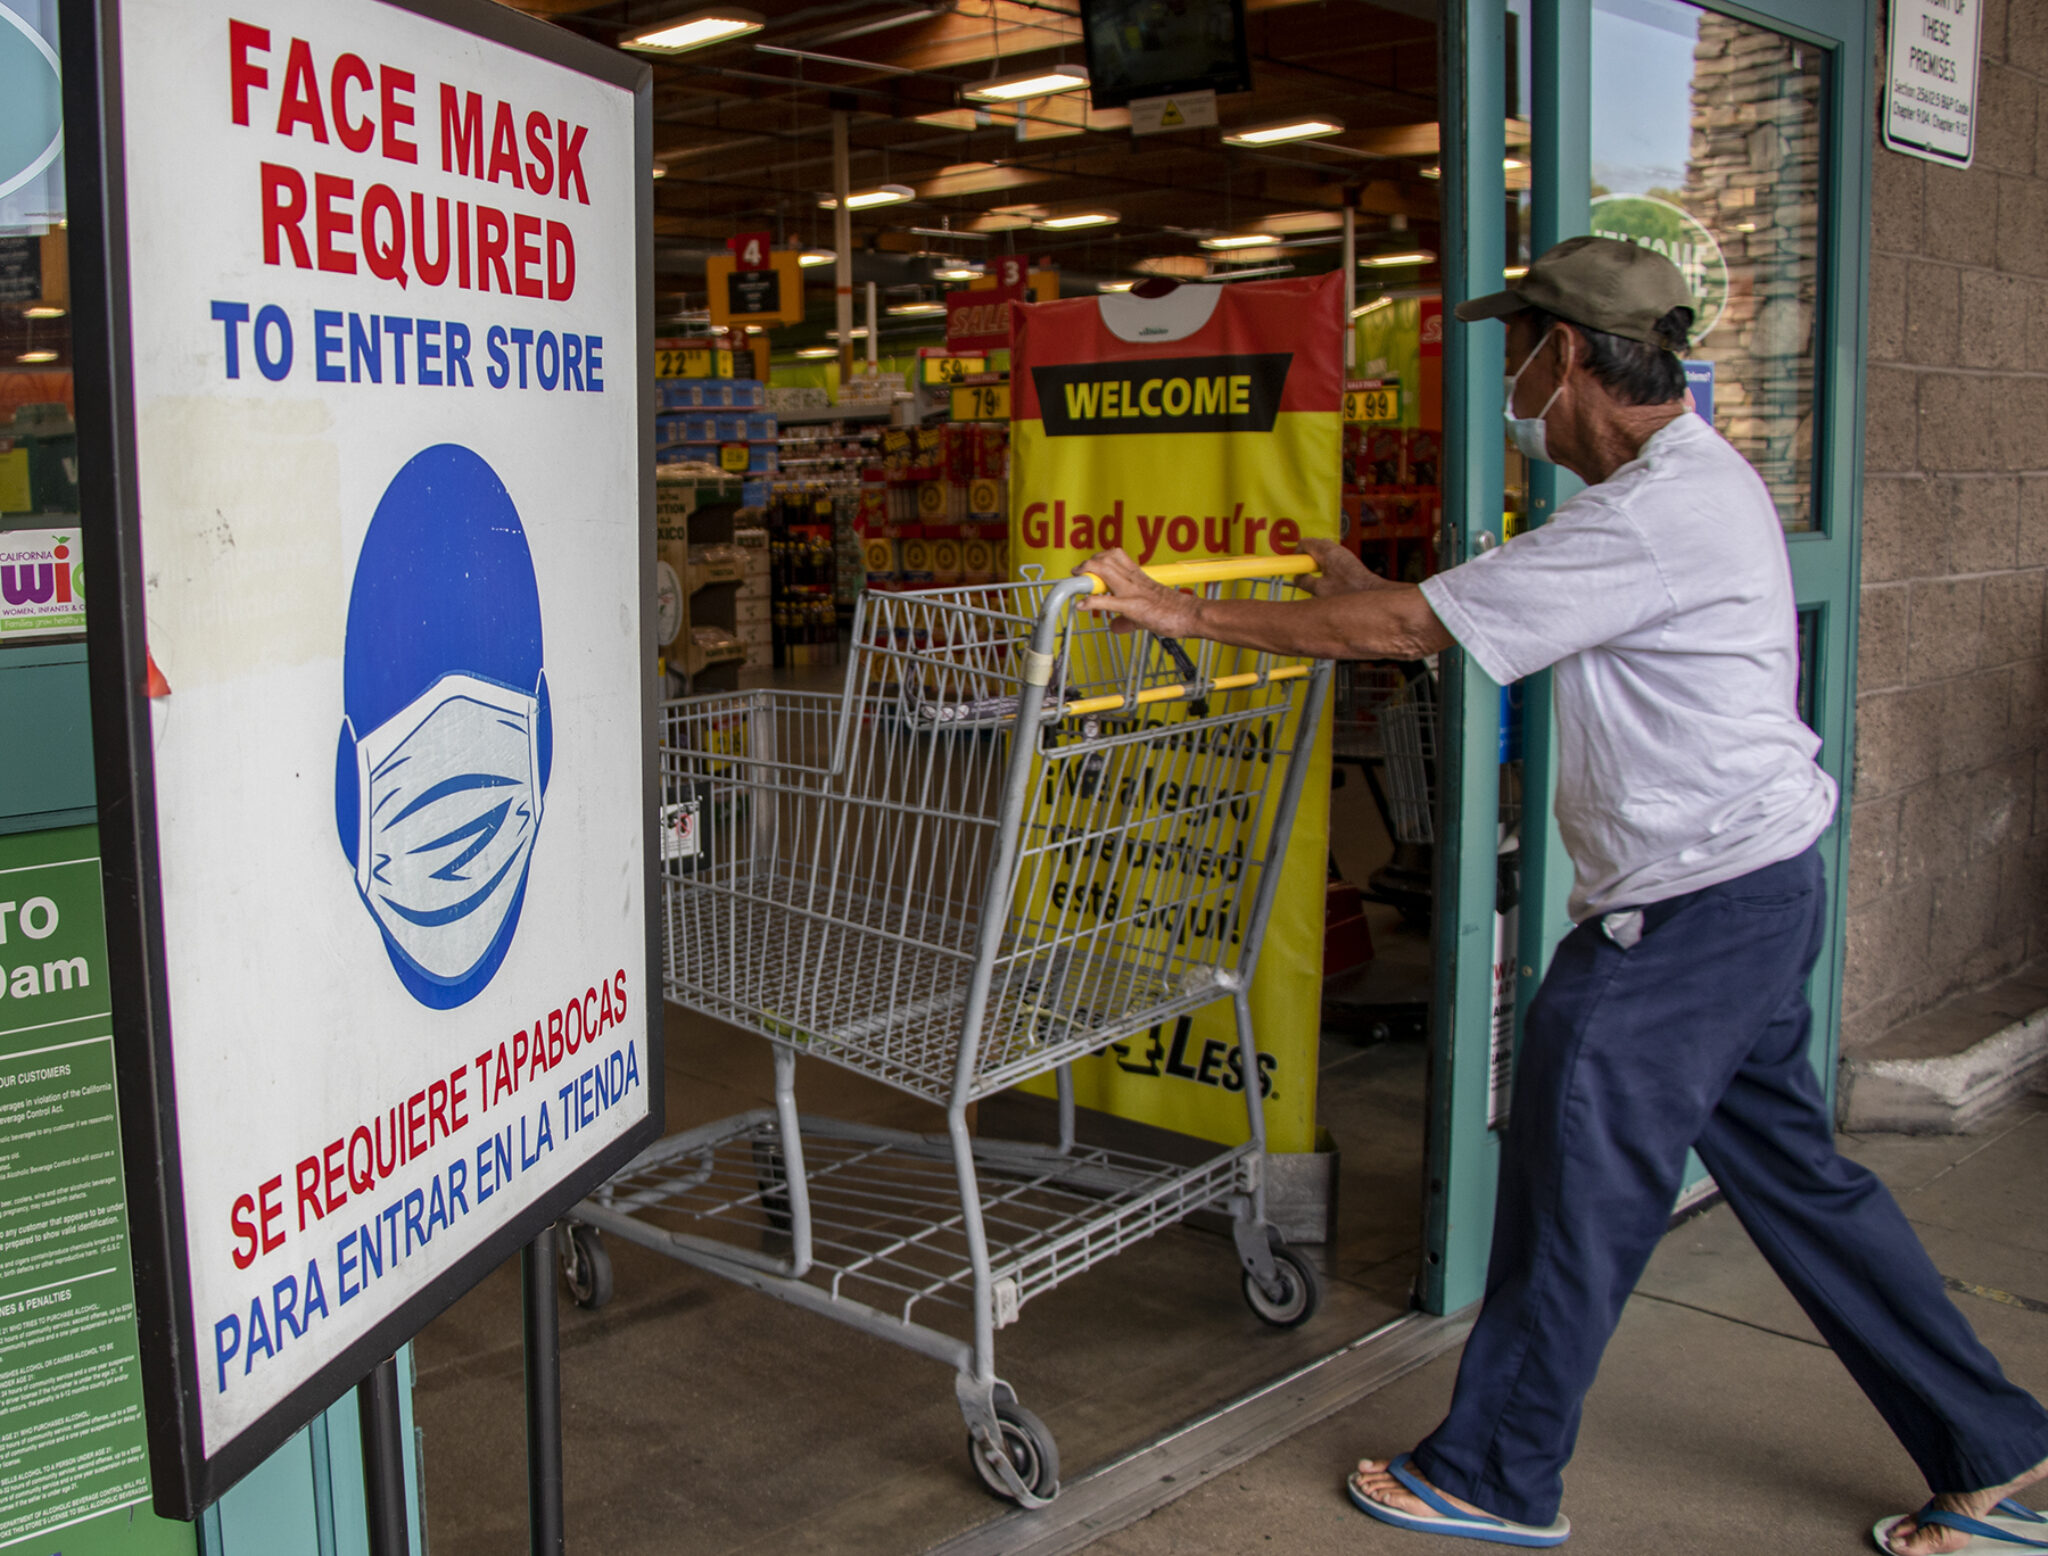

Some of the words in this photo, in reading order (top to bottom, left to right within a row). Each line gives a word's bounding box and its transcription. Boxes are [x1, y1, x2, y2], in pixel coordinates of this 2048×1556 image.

[1921, 14, 1951, 46] THESE
[229, 18, 418, 165] FACE
[440, 83, 590, 205] MASK
[260, 161, 576, 302] REQUIRED
[743, 240, 761, 266] 4
[1005, 262, 1019, 286] 3
[211, 300, 293, 381] TO
[314, 309, 474, 388] ENTER
[486, 325, 605, 393] STORE
[1064, 375, 1252, 421] WELCOME
[1021, 500, 1124, 551] Glad
[0, 551, 53, 561] CALIFORNIA
[1121, 767, 1251, 828] alegro
[0, 956, 90, 999] am
[17, 1064, 71, 1084] CUSTOMERS
[230, 1174, 287, 1270] SE
[296, 1064, 469, 1232] REQUIERE
[475, 968, 628, 1113] TAPABOCAS
[214, 1258, 330, 1394] PARA
[336, 1158, 470, 1307] ENTRAR
[476, 1124, 514, 1205] EN
[521, 1099, 554, 1173] LA
[557, 1039, 641, 1142] TIENDA
[18, 1301, 24, 1313] &
[26, 1290, 71, 1310] PENALTIES
